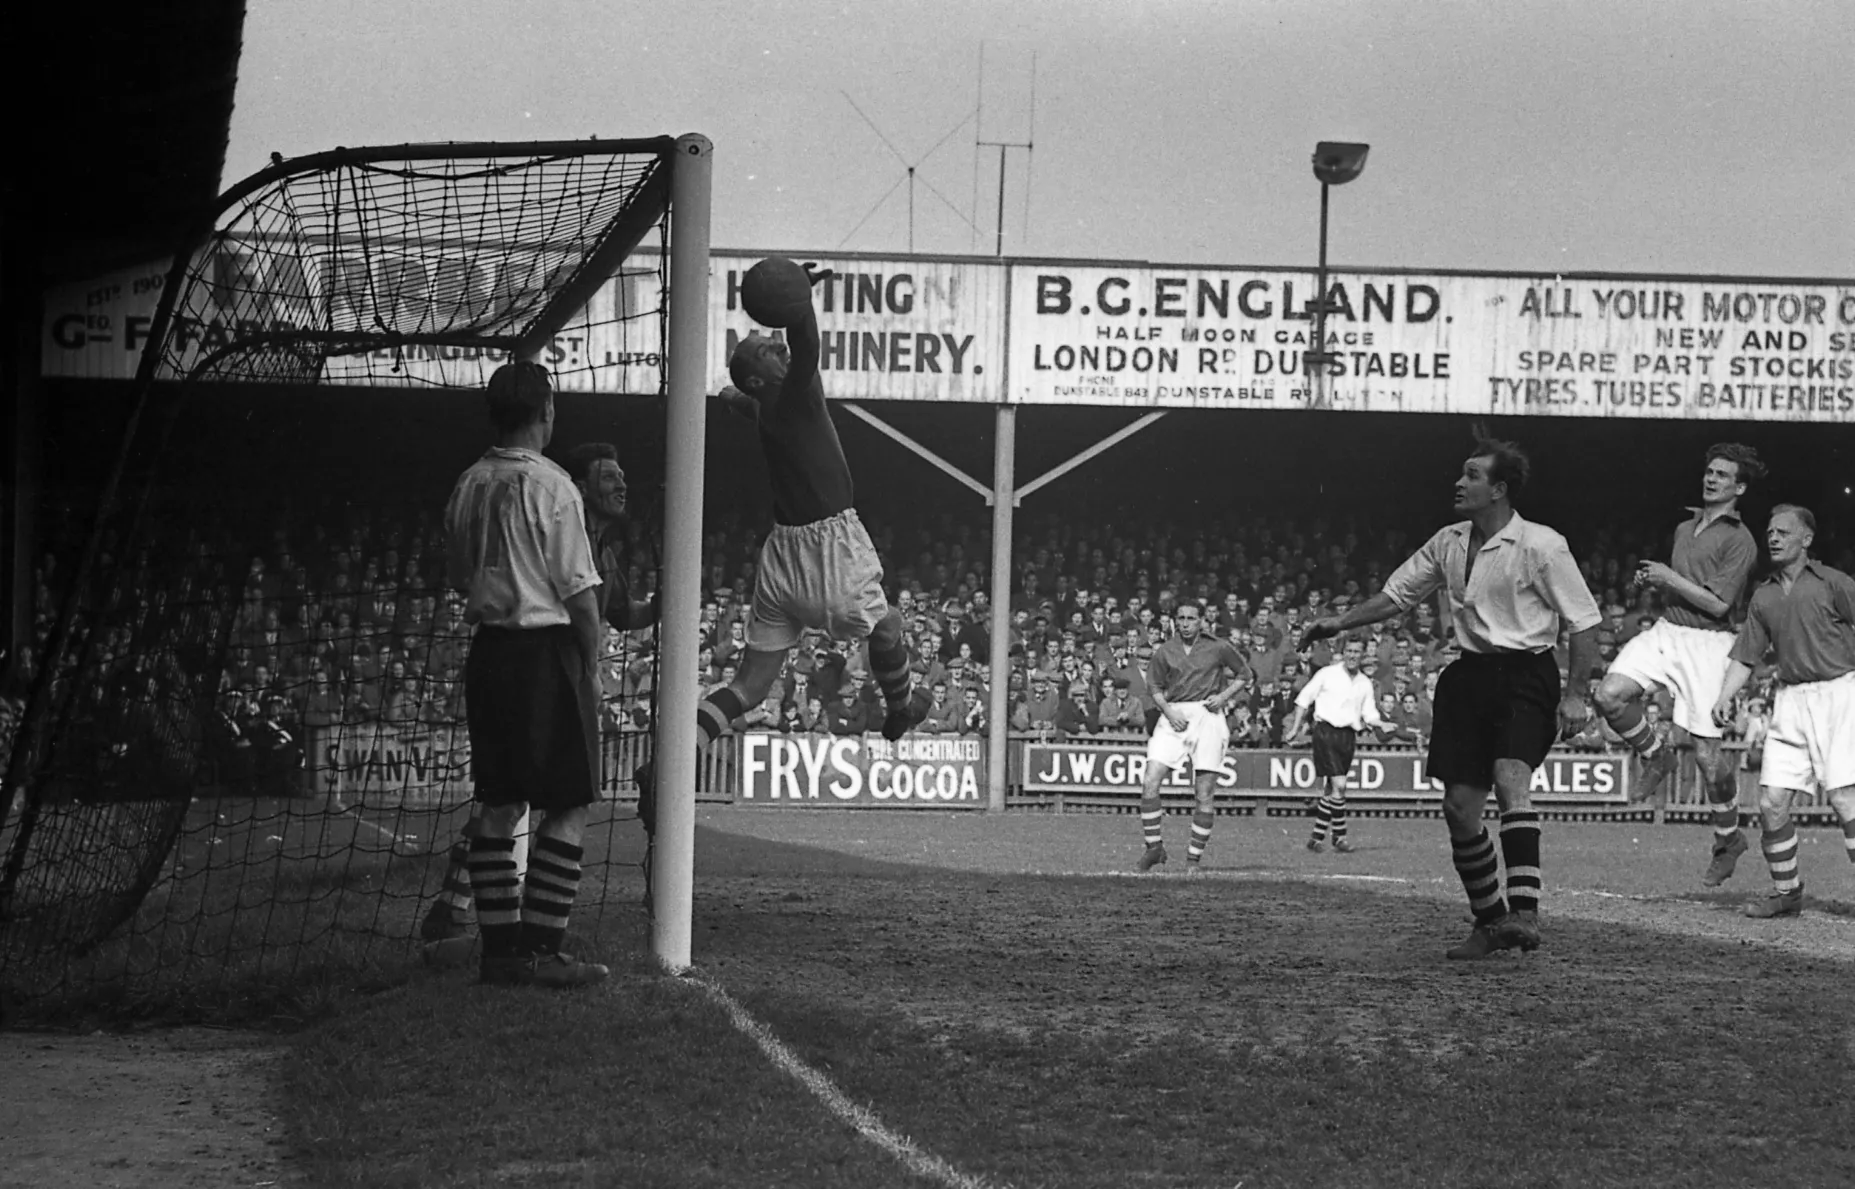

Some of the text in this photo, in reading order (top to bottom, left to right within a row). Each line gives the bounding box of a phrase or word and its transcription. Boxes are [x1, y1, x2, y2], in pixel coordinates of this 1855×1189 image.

[133, 274, 168, 295] 190
[726, 270, 914, 315] HTING
[1519, 287, 1582, 320] ALL
[1593, 289, 1684, 322] YOUR
[1703, 292, 1826, 325] MOTOR
[1096, 325, 1374, 346] HALF MOON GARAGE
[1656, 327, 1724, 350] NEW
[1741, 330, 1808, 352] AND
[605, 350, 672, 368] LUTO
[726, 329, 983, 376] HINERY.
[1034, 344, 1179, 374] LONDON
[1518, 350, 1617, 373] SPARE
[1633, 354, 1715, 376] PART
[1124, 387, 1149, 400] 843
[1157, 386, 1276, 401] DUNSTABLE
[1593, 380, 1682, 408] TUBES
[1698, 383, 1855, 412] BATTERIES
[325, 743, 475, 784] SWAN VES
[898, 739, 981, 761] CONCENTRATED
[868, 761, 980, 800] COCOA
[1269, 757, 1385, 790] NOED
[1529, 761, 1615, 793] ALES
